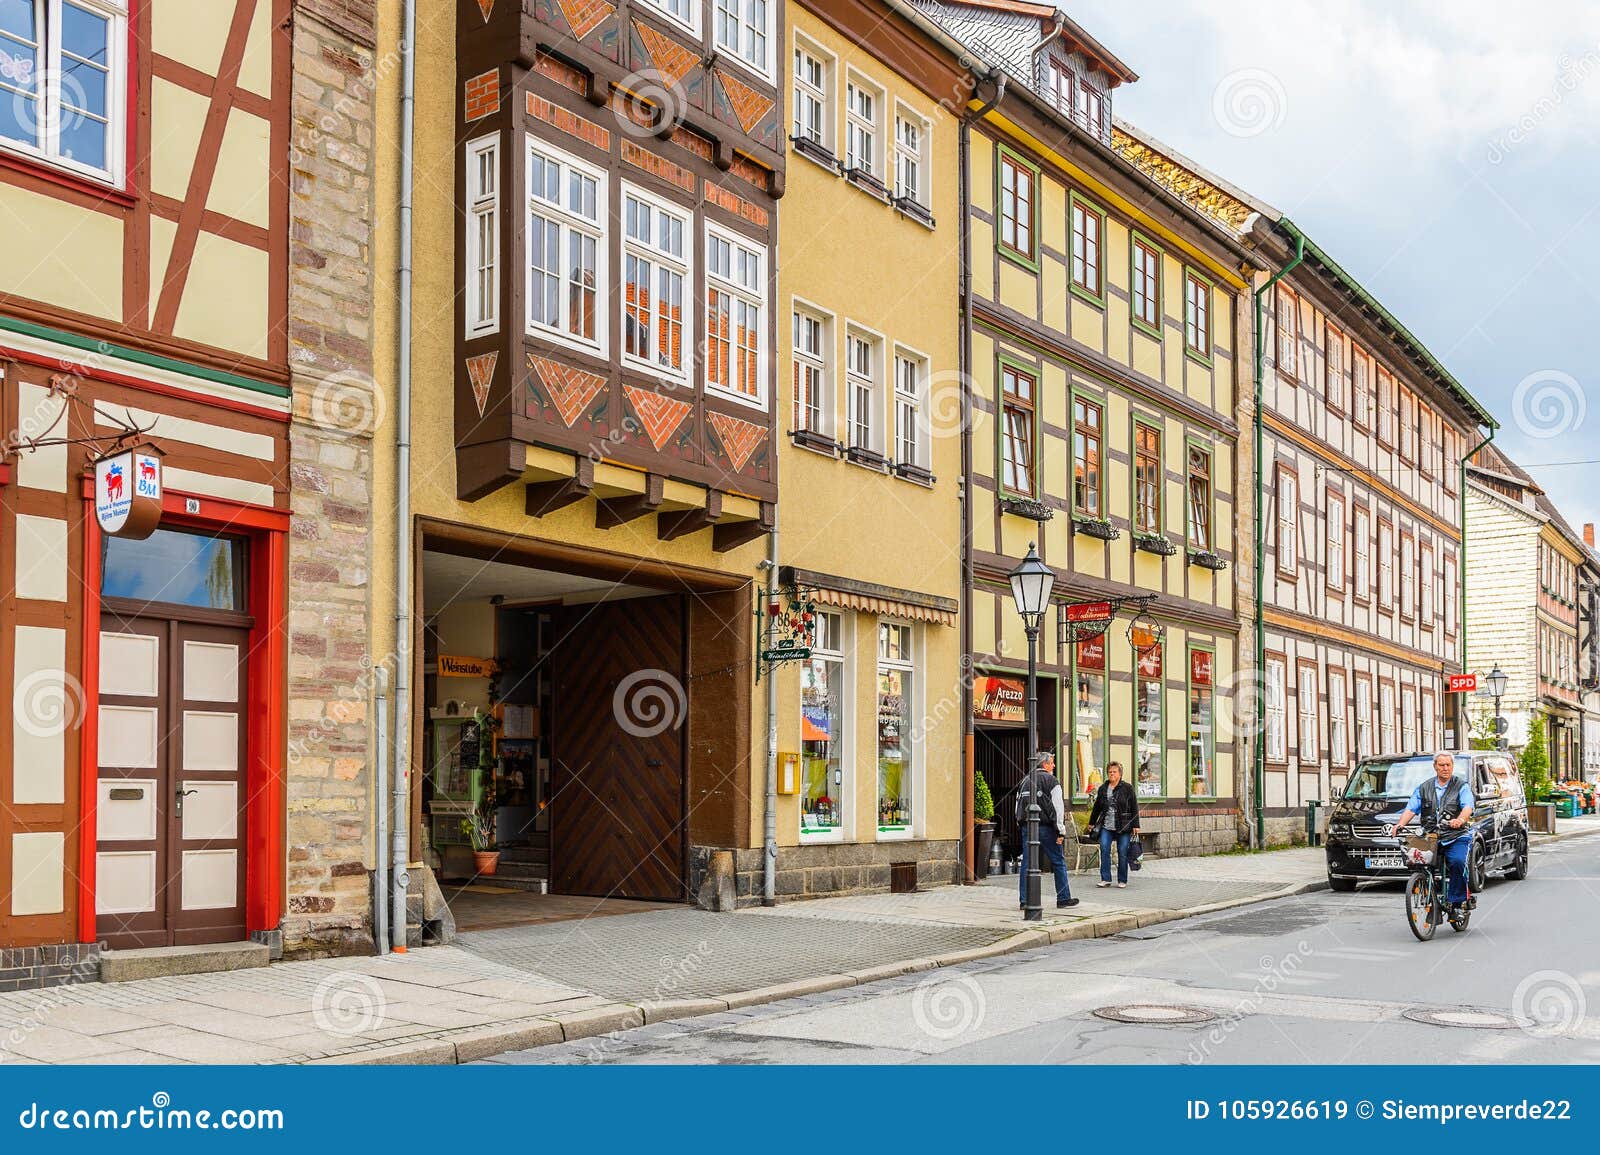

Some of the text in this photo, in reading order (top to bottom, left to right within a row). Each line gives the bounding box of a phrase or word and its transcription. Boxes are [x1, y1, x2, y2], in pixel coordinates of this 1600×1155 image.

[778, 612, 790, 627] 88
[441, 657, 482, 674] Weinstube
[1452, 678, 1475, 689] SPD
[997, 687, 1023, 701] Arezzo
